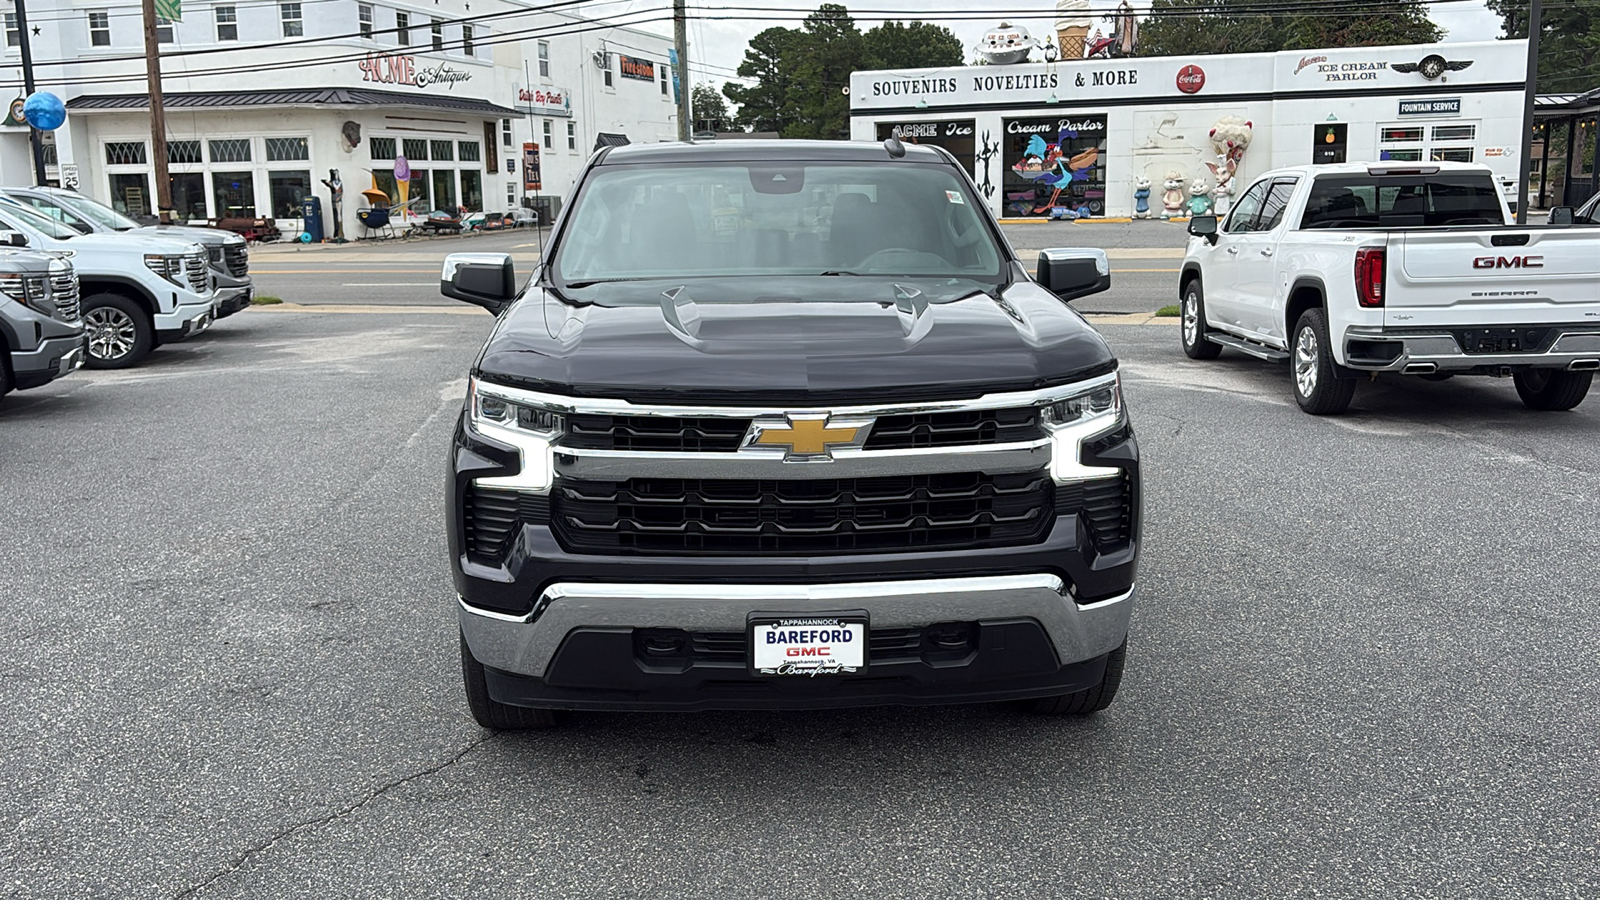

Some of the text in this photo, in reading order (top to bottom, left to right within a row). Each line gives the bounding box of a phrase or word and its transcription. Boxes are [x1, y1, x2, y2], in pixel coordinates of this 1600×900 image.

[358, 51, 416, 86] ACME
[1318, 62, 1387, 72] ICE CREAM
[873, 70, 1138, 96] SOUVENIRS NOVELTIES & MORE
[1326, 72, 1376, 81] PARLOR
[1401, 102, 1458, 112] FOUNTAIN SERVICE
[894, 119, 1104, 138] ACME Ice Cream Parlor
[65, 177, 78, 186] 25
[1473, 256, 1544, 269] GMC
[766, 630, 853, 644] BAREFORD
[786, 647, 831, 657] GMC
[776, 663, 843, 678] Bareford
